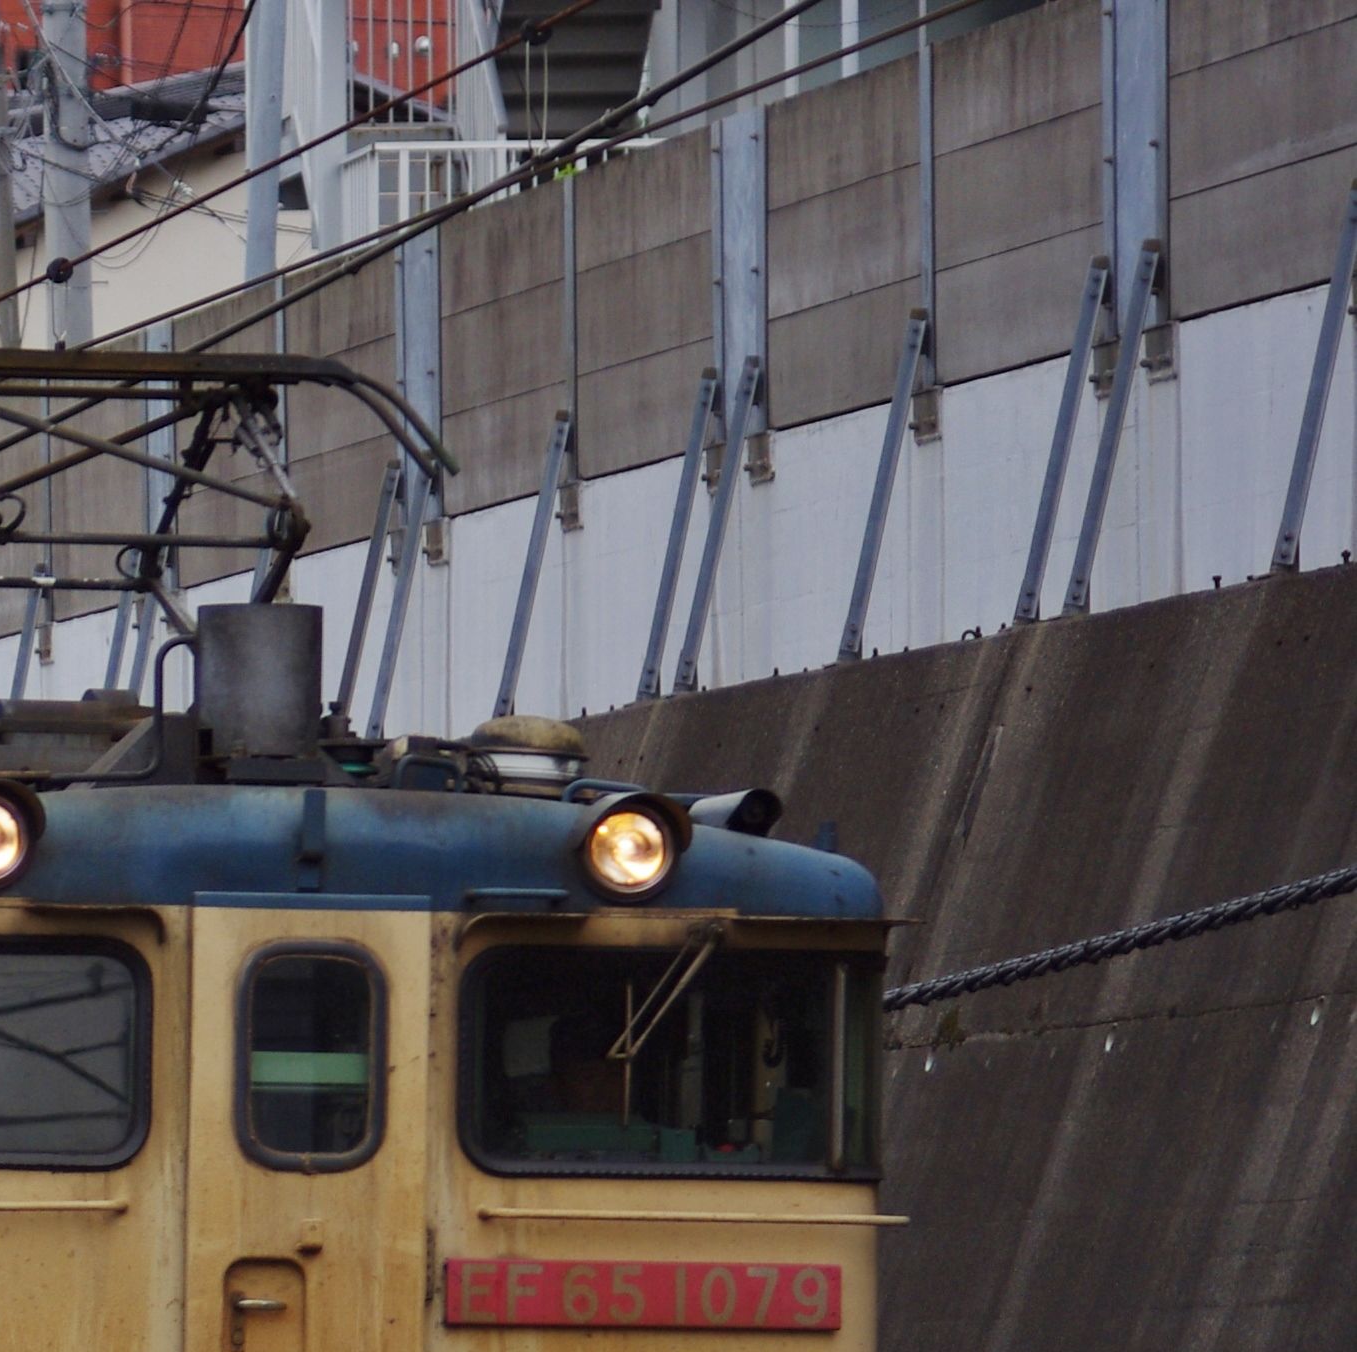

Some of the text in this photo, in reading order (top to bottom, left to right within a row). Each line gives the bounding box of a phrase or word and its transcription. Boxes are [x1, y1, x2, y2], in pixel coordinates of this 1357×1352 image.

[460, 1263, 830, 1325] EF 65 1079
